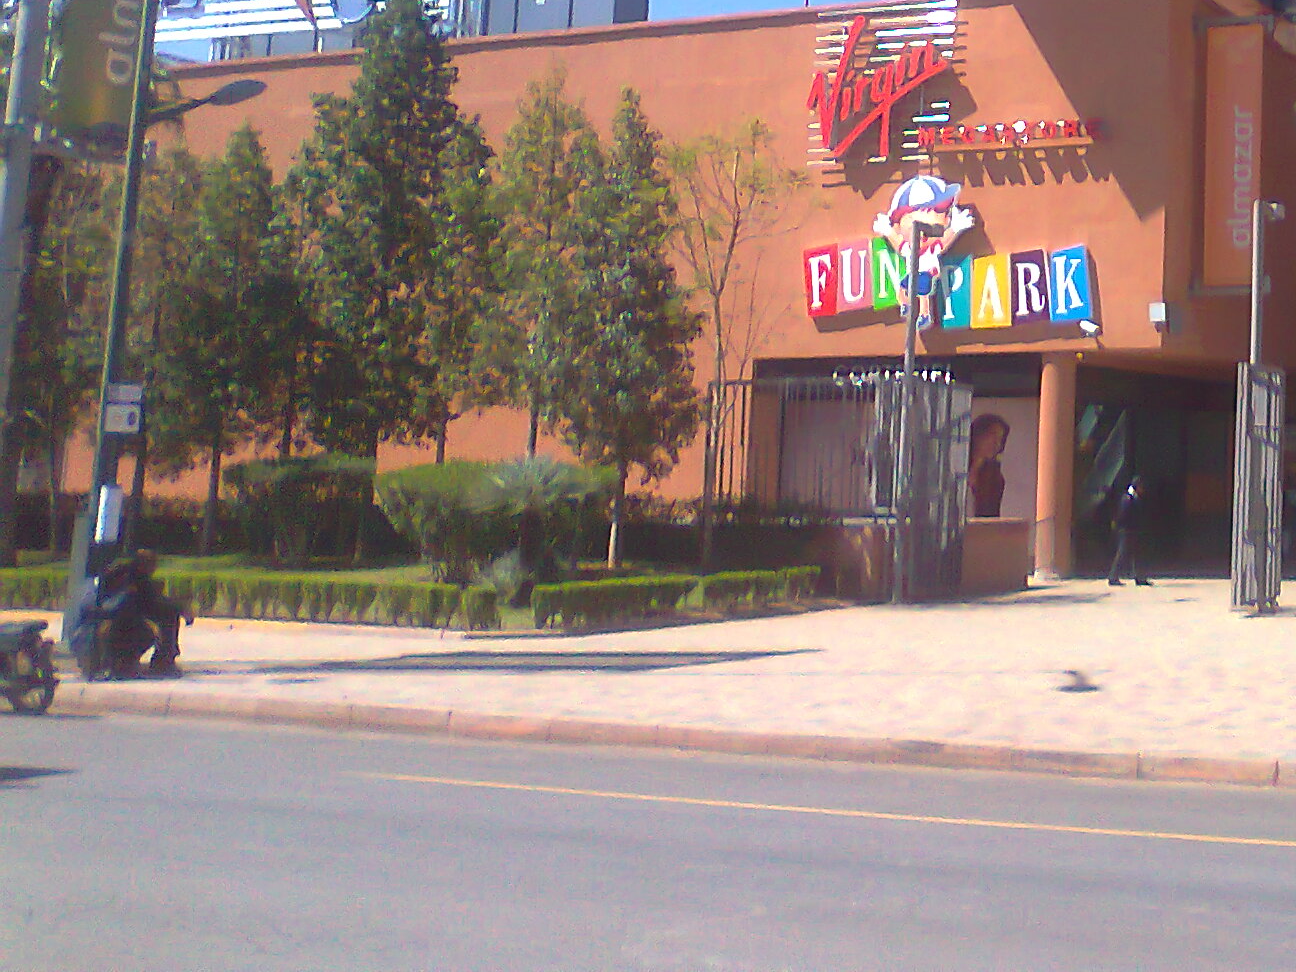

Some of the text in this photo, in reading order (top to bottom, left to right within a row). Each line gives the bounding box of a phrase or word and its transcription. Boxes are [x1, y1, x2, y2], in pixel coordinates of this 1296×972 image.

[806, 14, 949, 159] Virgin
[1226, 103, 1255, 250] almazar
[808, 247, 1085, 320] FUN PARK
